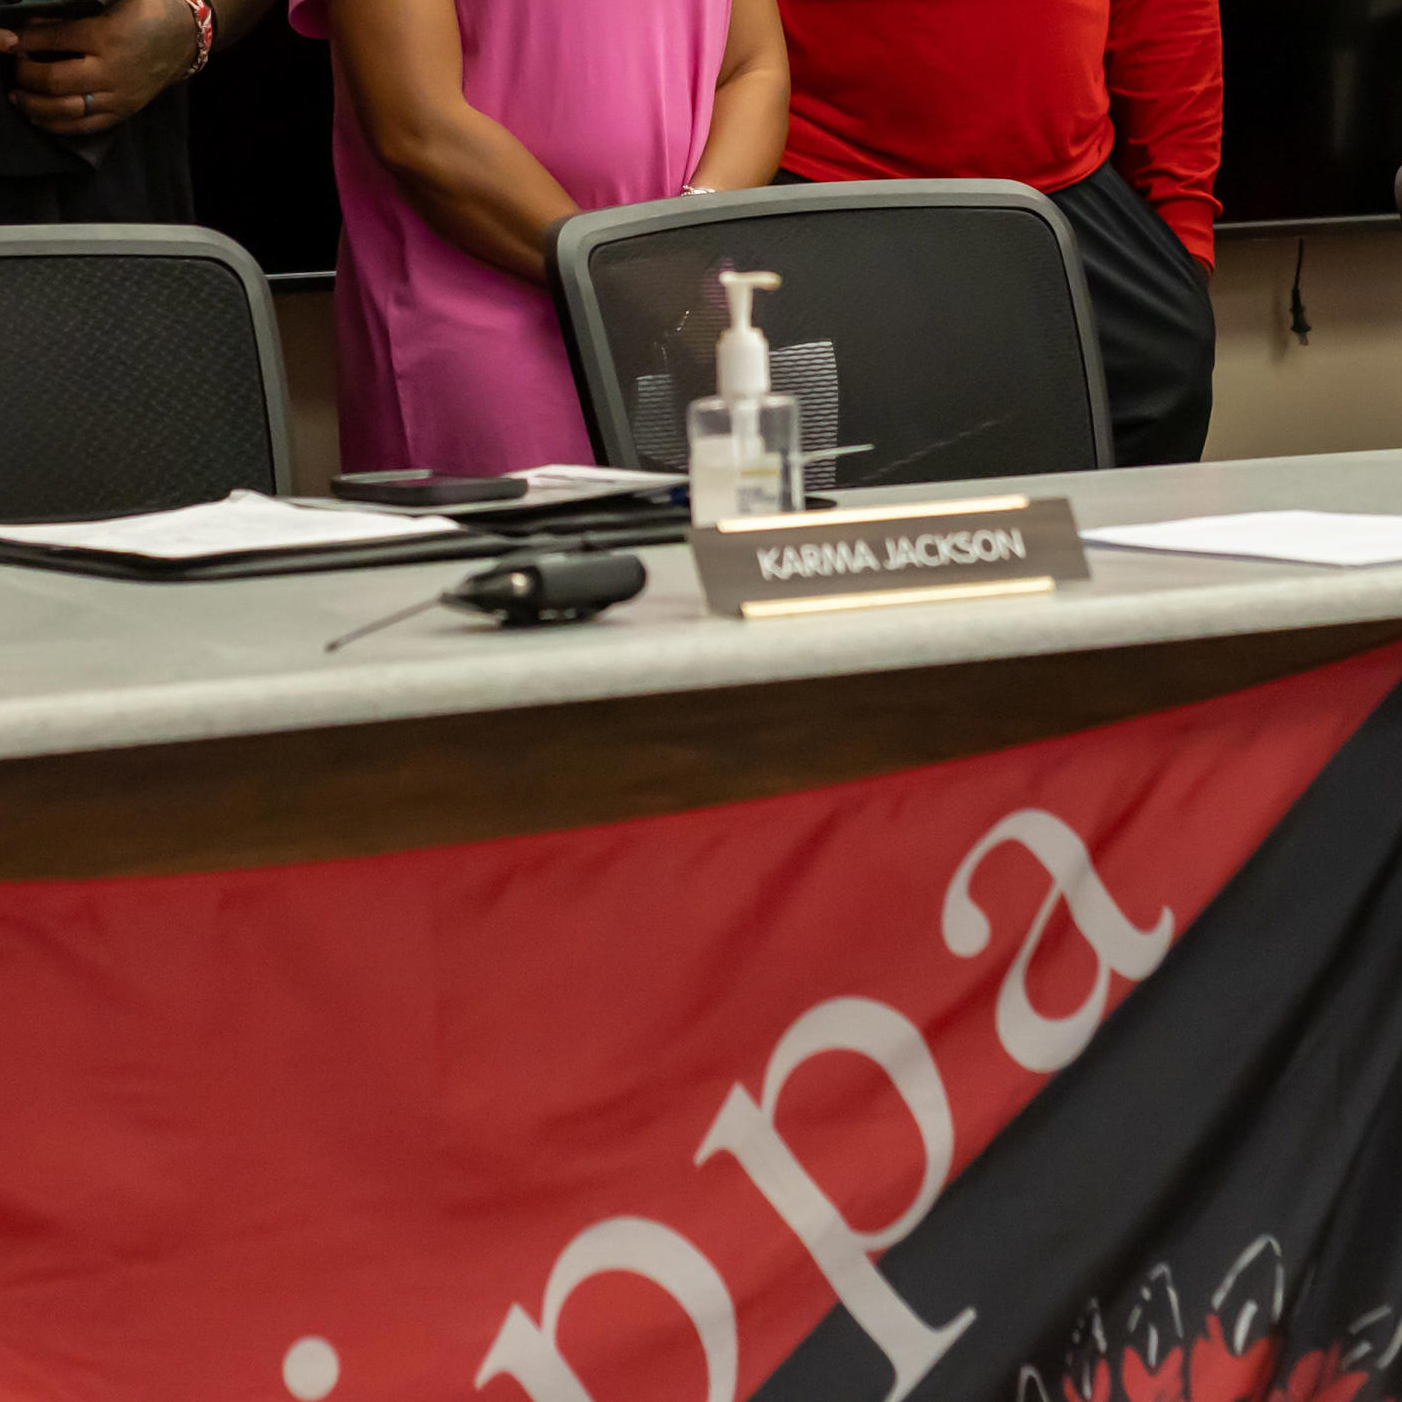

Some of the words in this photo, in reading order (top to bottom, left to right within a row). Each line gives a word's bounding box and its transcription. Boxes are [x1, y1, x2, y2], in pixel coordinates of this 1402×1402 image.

[756, 539, 880, 581] KARMA
[882, 528, 1028, 571] JACKSON
[282, 808, 1175, 1402] ppa
